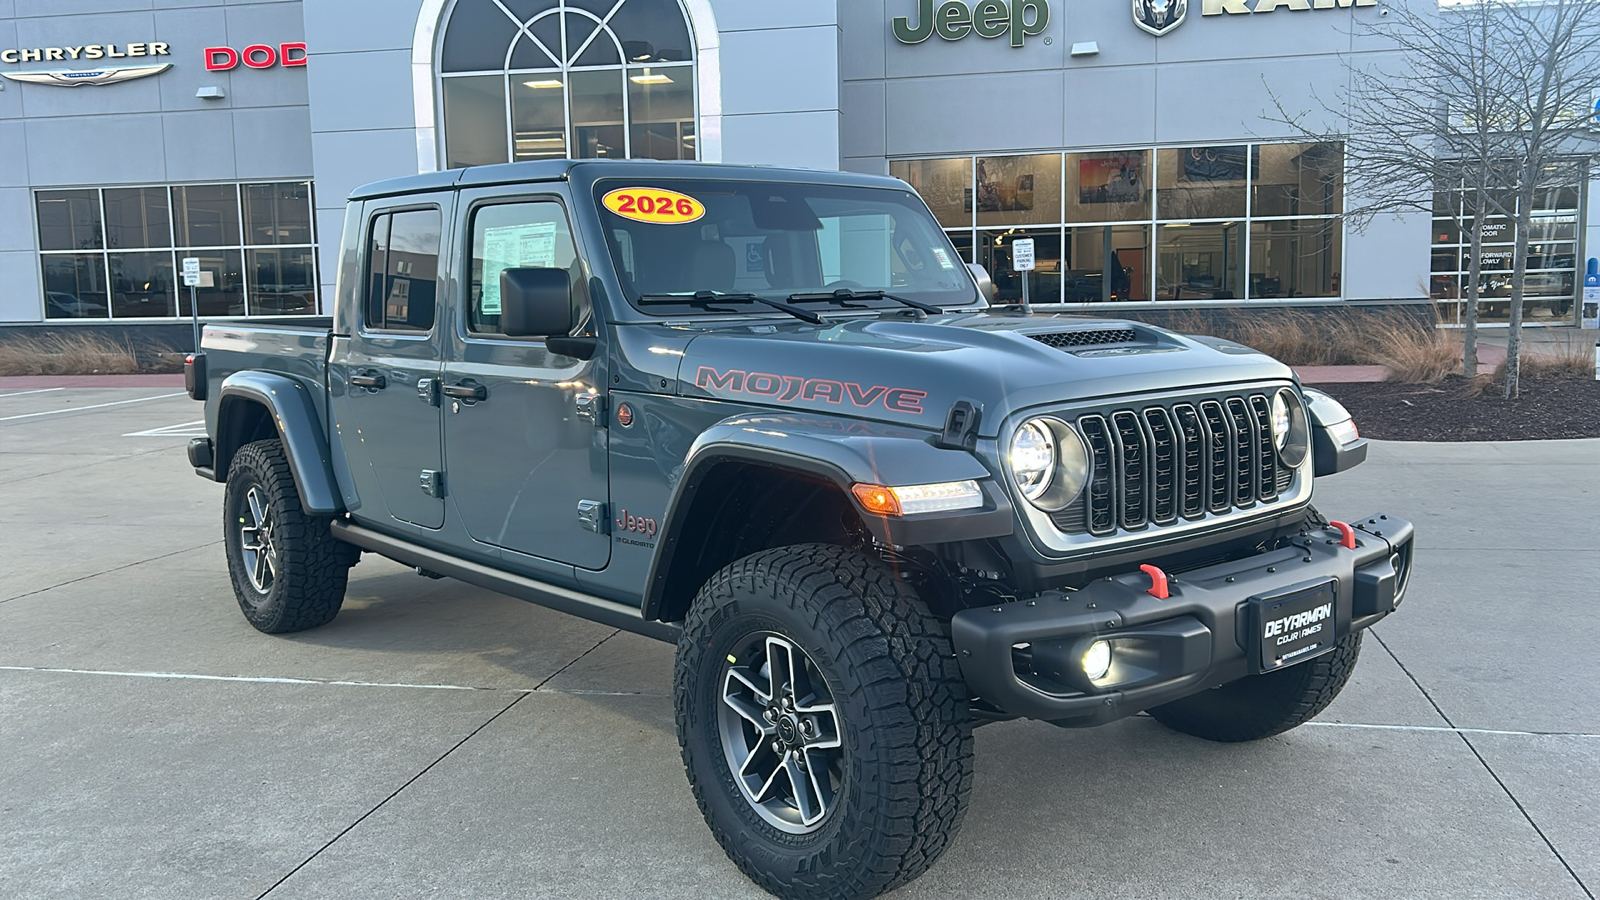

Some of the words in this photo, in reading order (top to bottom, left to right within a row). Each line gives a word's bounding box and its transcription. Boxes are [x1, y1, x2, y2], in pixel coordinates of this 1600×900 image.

[892, 0, 1050, 48] Jeep
[0, 41, 170, 63] CHRYSLER
[203, 42, 307, 71] DOD
[617, 194, 693, 217] 2026
[695, 366, 927, 414] MOJAVE
[616, 509, 657, 540] Jeep
[1264, 603, 1332, 638] DEYARMAN
[1301, 623, 1323, 637] AMES
